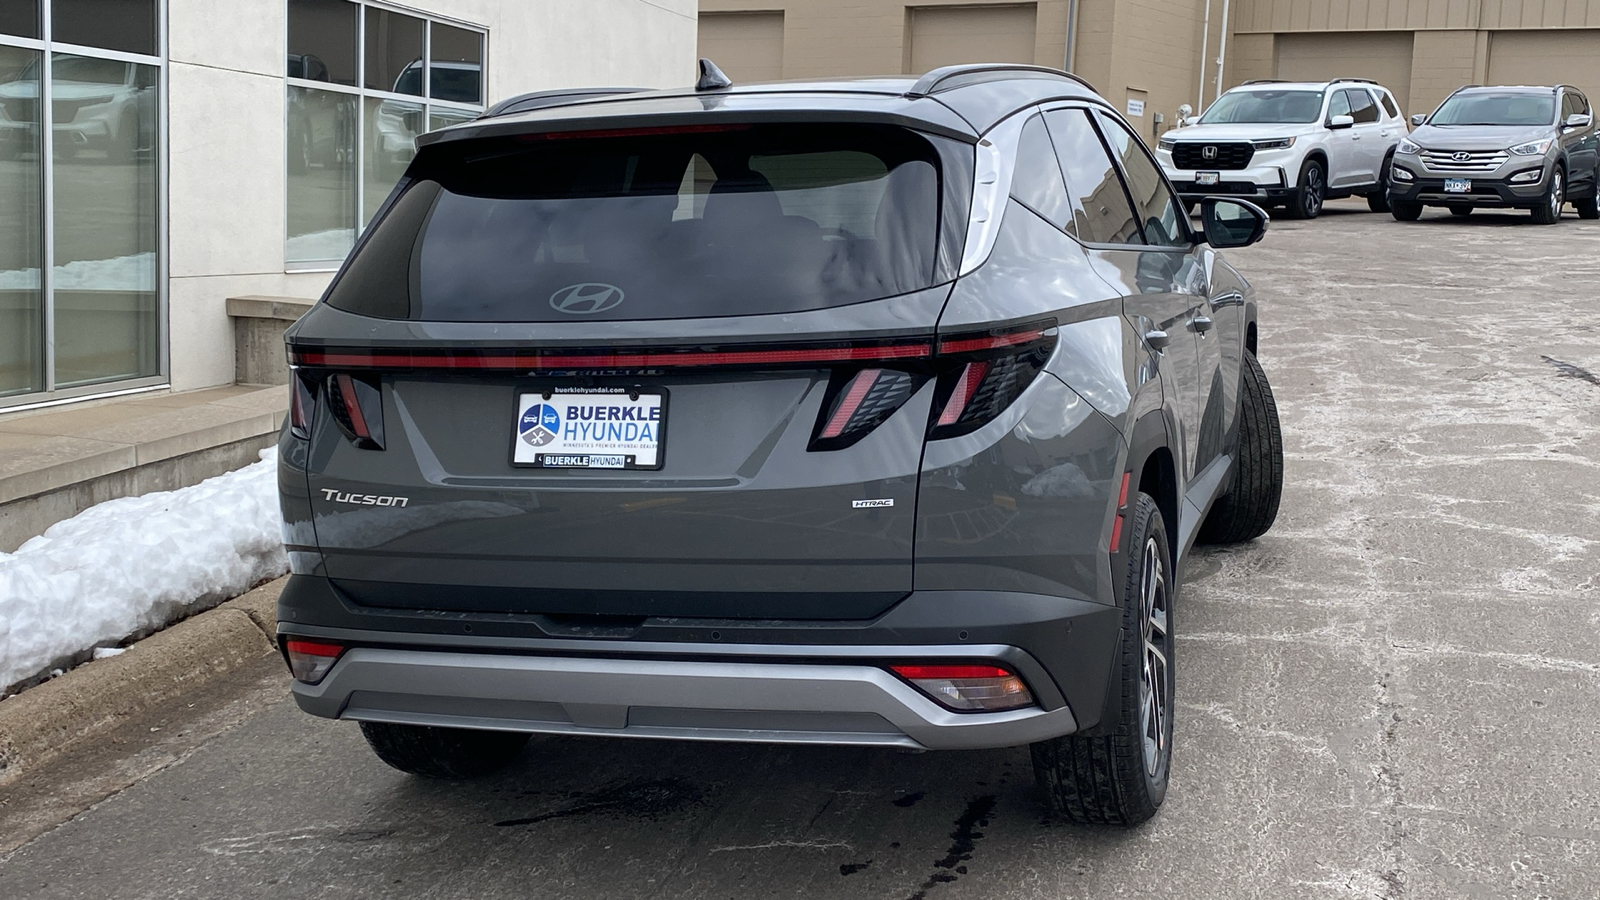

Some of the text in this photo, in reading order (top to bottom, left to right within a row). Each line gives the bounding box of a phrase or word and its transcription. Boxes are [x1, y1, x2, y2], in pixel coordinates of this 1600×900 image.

[555, 386, 625, 394] buerklehyundai.com
[566, 406, 660, 421] BUERKLE
[564, 422, 659, 442] HYUNDAI
[545, 456, 624, 466] BUERKLE HYUNDAI
